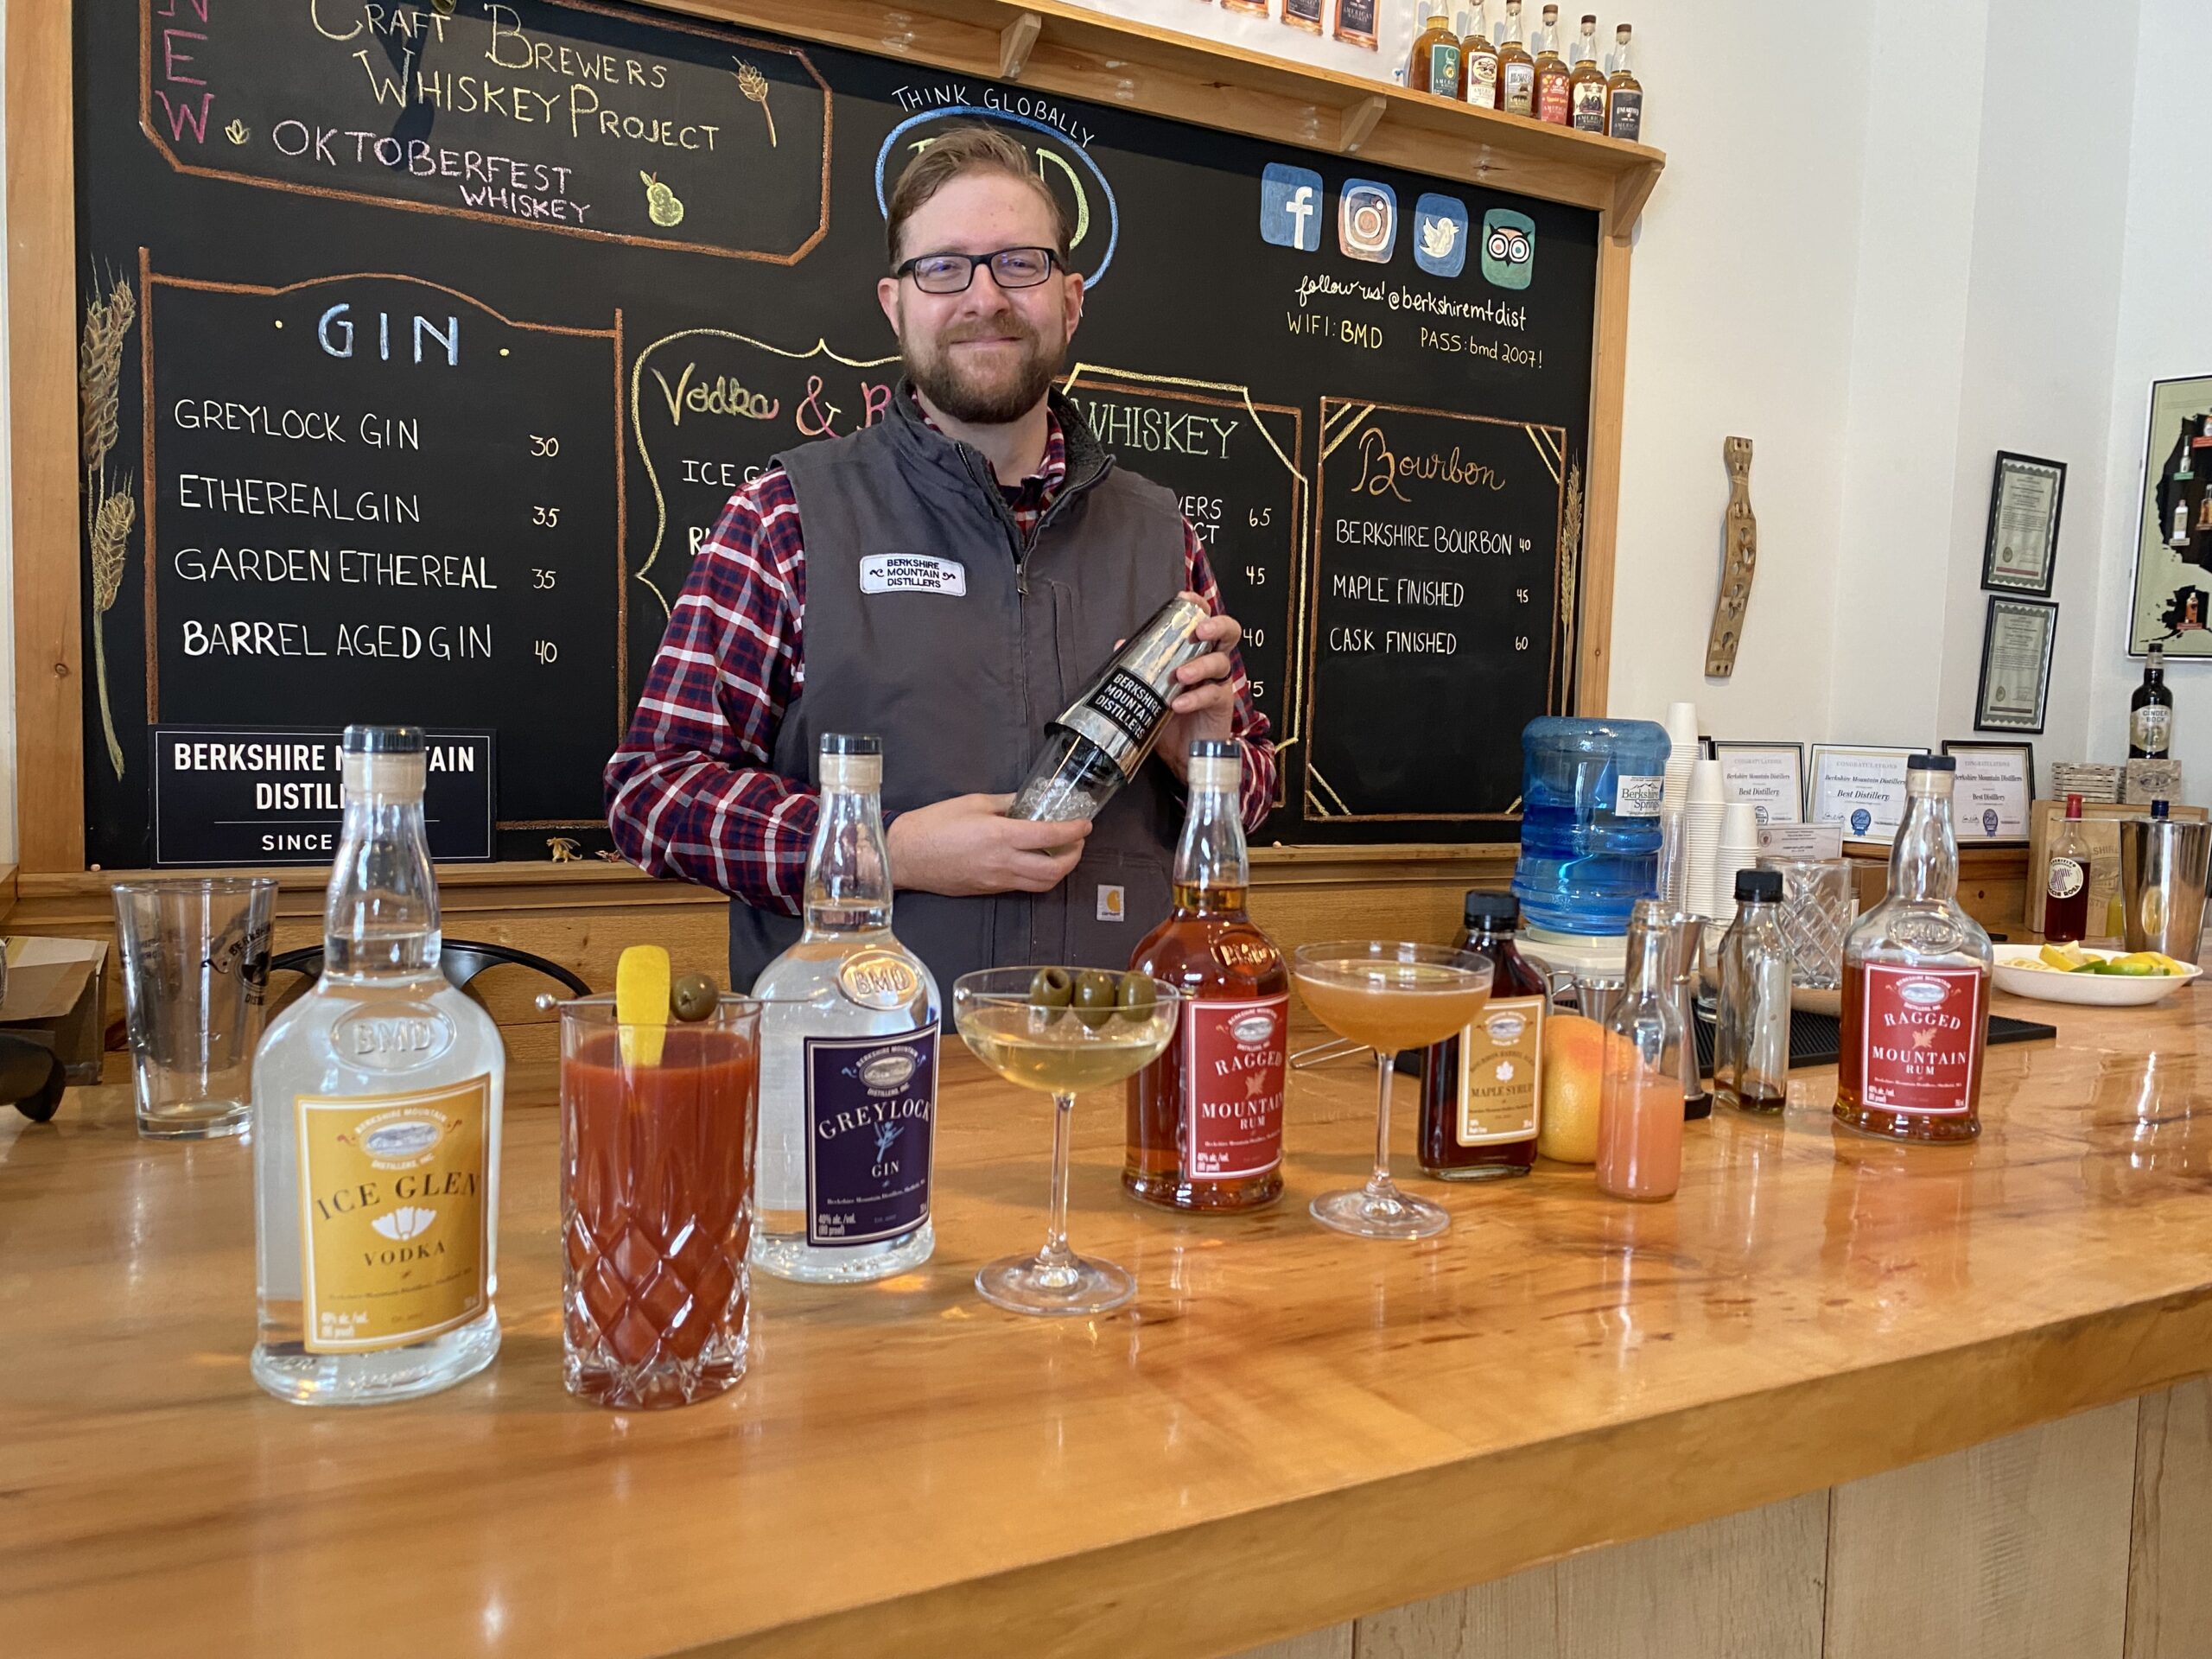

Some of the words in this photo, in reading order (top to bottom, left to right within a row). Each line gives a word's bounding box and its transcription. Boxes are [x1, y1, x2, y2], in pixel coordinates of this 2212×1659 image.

[309, 0, 451, 44] CRAFT
[482, 3, 670, 90] BREWERS
[353, 47, 560, 125] WHISKEY
[568, 83, 721, 152] PROJECT
[892, 84, 970, 112] THINK
[984, 88, 1095, 148] GLOBALLY
[271, 118, 573, 194] OKTOBERFEST
[458, 184, 592, 225] WHISKEY
[1295, 274, 1358, 307] follow
[1388, 286, 1527, 331] @berkshiremtdist
[318, 303, 459, 365] GIN
[650, 362, 779, 426] Vodka
[796, 375, 842, 438] &
[174, 399, 346, 442] GREYLOCK
[360, 413, 420, 450] GIN
[530, 435, 559, 457] 30
[1071, 397, 1239, 460] WHISKEY
[682, 460, 736, 487] ICE
[1351, 427, 1505, 502] Bourbon
[179, 474, 354, 522] ETHEREAL
[356, 492, 420, 524] GIN
[532, 506, 560, 528] 35
[1249, 508, 1272, 527] 65
[1336, 519, 1429, 548] BERKSHIRE
[1434, 525, 1512, 555] BOURBON
[1519, 537, 1531, 553] 40
[174, 548, 330, 583] GARDEN
[341, 550, 498, 589] ETHEREAL
[531, 569, 556, 589] 35
[887, 559, 939, 569] BERKSHIRE
[887, 569, 939, 579] MOUNTAIN
[1246, 565, 1265, 585] 45
[887, 577, 941, 588] DISTILLERS
[1333, 574, 1389, 602] MAPLE
[1397, 578, 1464, 607] FINISHED
[1516, 588, 1529, 603] 45
[183, 620, 327, 658] BARREL
[337, 624, 423, 659] AGED
[429, 623, 492, 660] GIN
[535, 639, 557, 664] 40
[1243, 628, 1264, 647] 40
[1330, 627, 1376, 652] CASK
[1386, 631, 1456, 654] FINISHED
[1515, 636, 1528, 650] 60
[1103, 683, 1153, 728] MOUNTAIN
[1113, 673, 1161, 716] BERKSHIRE
[1095, 694, 1145, 739] DISTILLERS
[175, 743, 326, 772] BERKSHIRE
[1738, 787, 1751, 796] Best
[1752, 787, 1779, 797] Distillery
[1837, 789, 1853, 798] Best
[1854, 790, 1890, 802] Distillery
[1984, 793, 2005, 802] Distillery
[262, 833, 333, 851] SINCE
[1884, 1011, 1961, 1030] RAGGED
[1215, 1051, 1283, 1076] RAGGED
[1872, 1046, 1966, 1065] MOUNTAIN
[1906, 1064, 1935, 1075] RUM
[1471, 1086, 1503, 1097] MAPLE
[818, 1098, 930, 1139] GREYLOCK
[1240, 1115, 1266, 1130] RUM
[871, 1160, 899, 1178] GIN
[315, 1181, 382, 1222] ICE
[395, 1171, 480, 1200] GLEN
[364, 1239, 445, 1266] VODKA
